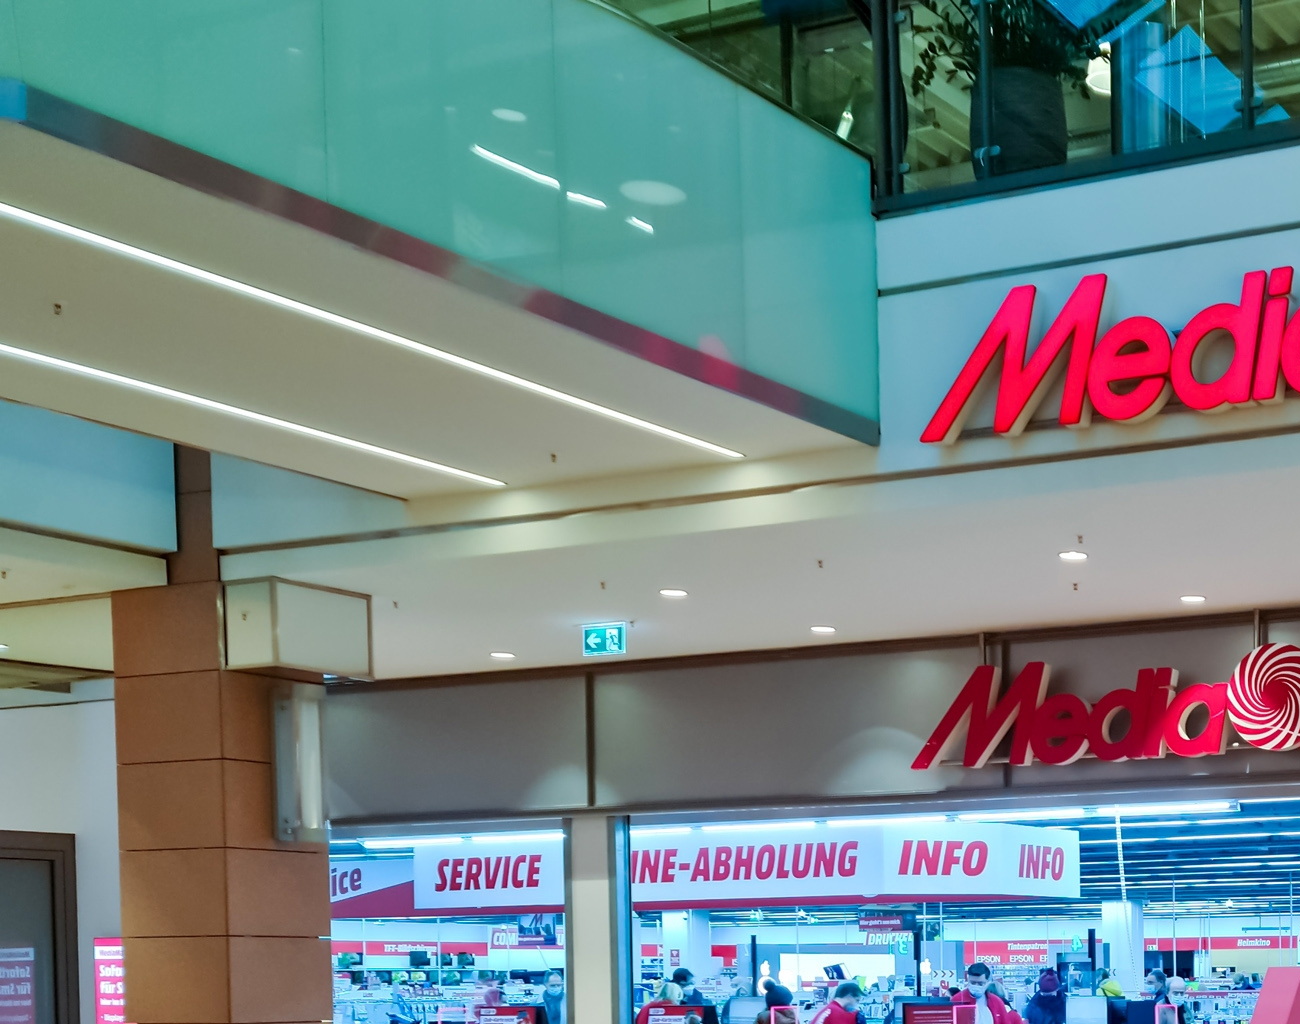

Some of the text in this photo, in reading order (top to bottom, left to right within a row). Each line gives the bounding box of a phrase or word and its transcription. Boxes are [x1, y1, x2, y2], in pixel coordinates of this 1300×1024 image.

[911, 660, 1228, 770] Media
[434, 854, 543, 893] SERVICE
[897, 839, 989, 877] INFO
[1018, 843, 1065, 882] INFO
[976, 955, 1001, 963] EPSON
[1009, 954, 1034, 963] EPSON
[1237, 938, 1271, 947] Heimkino
